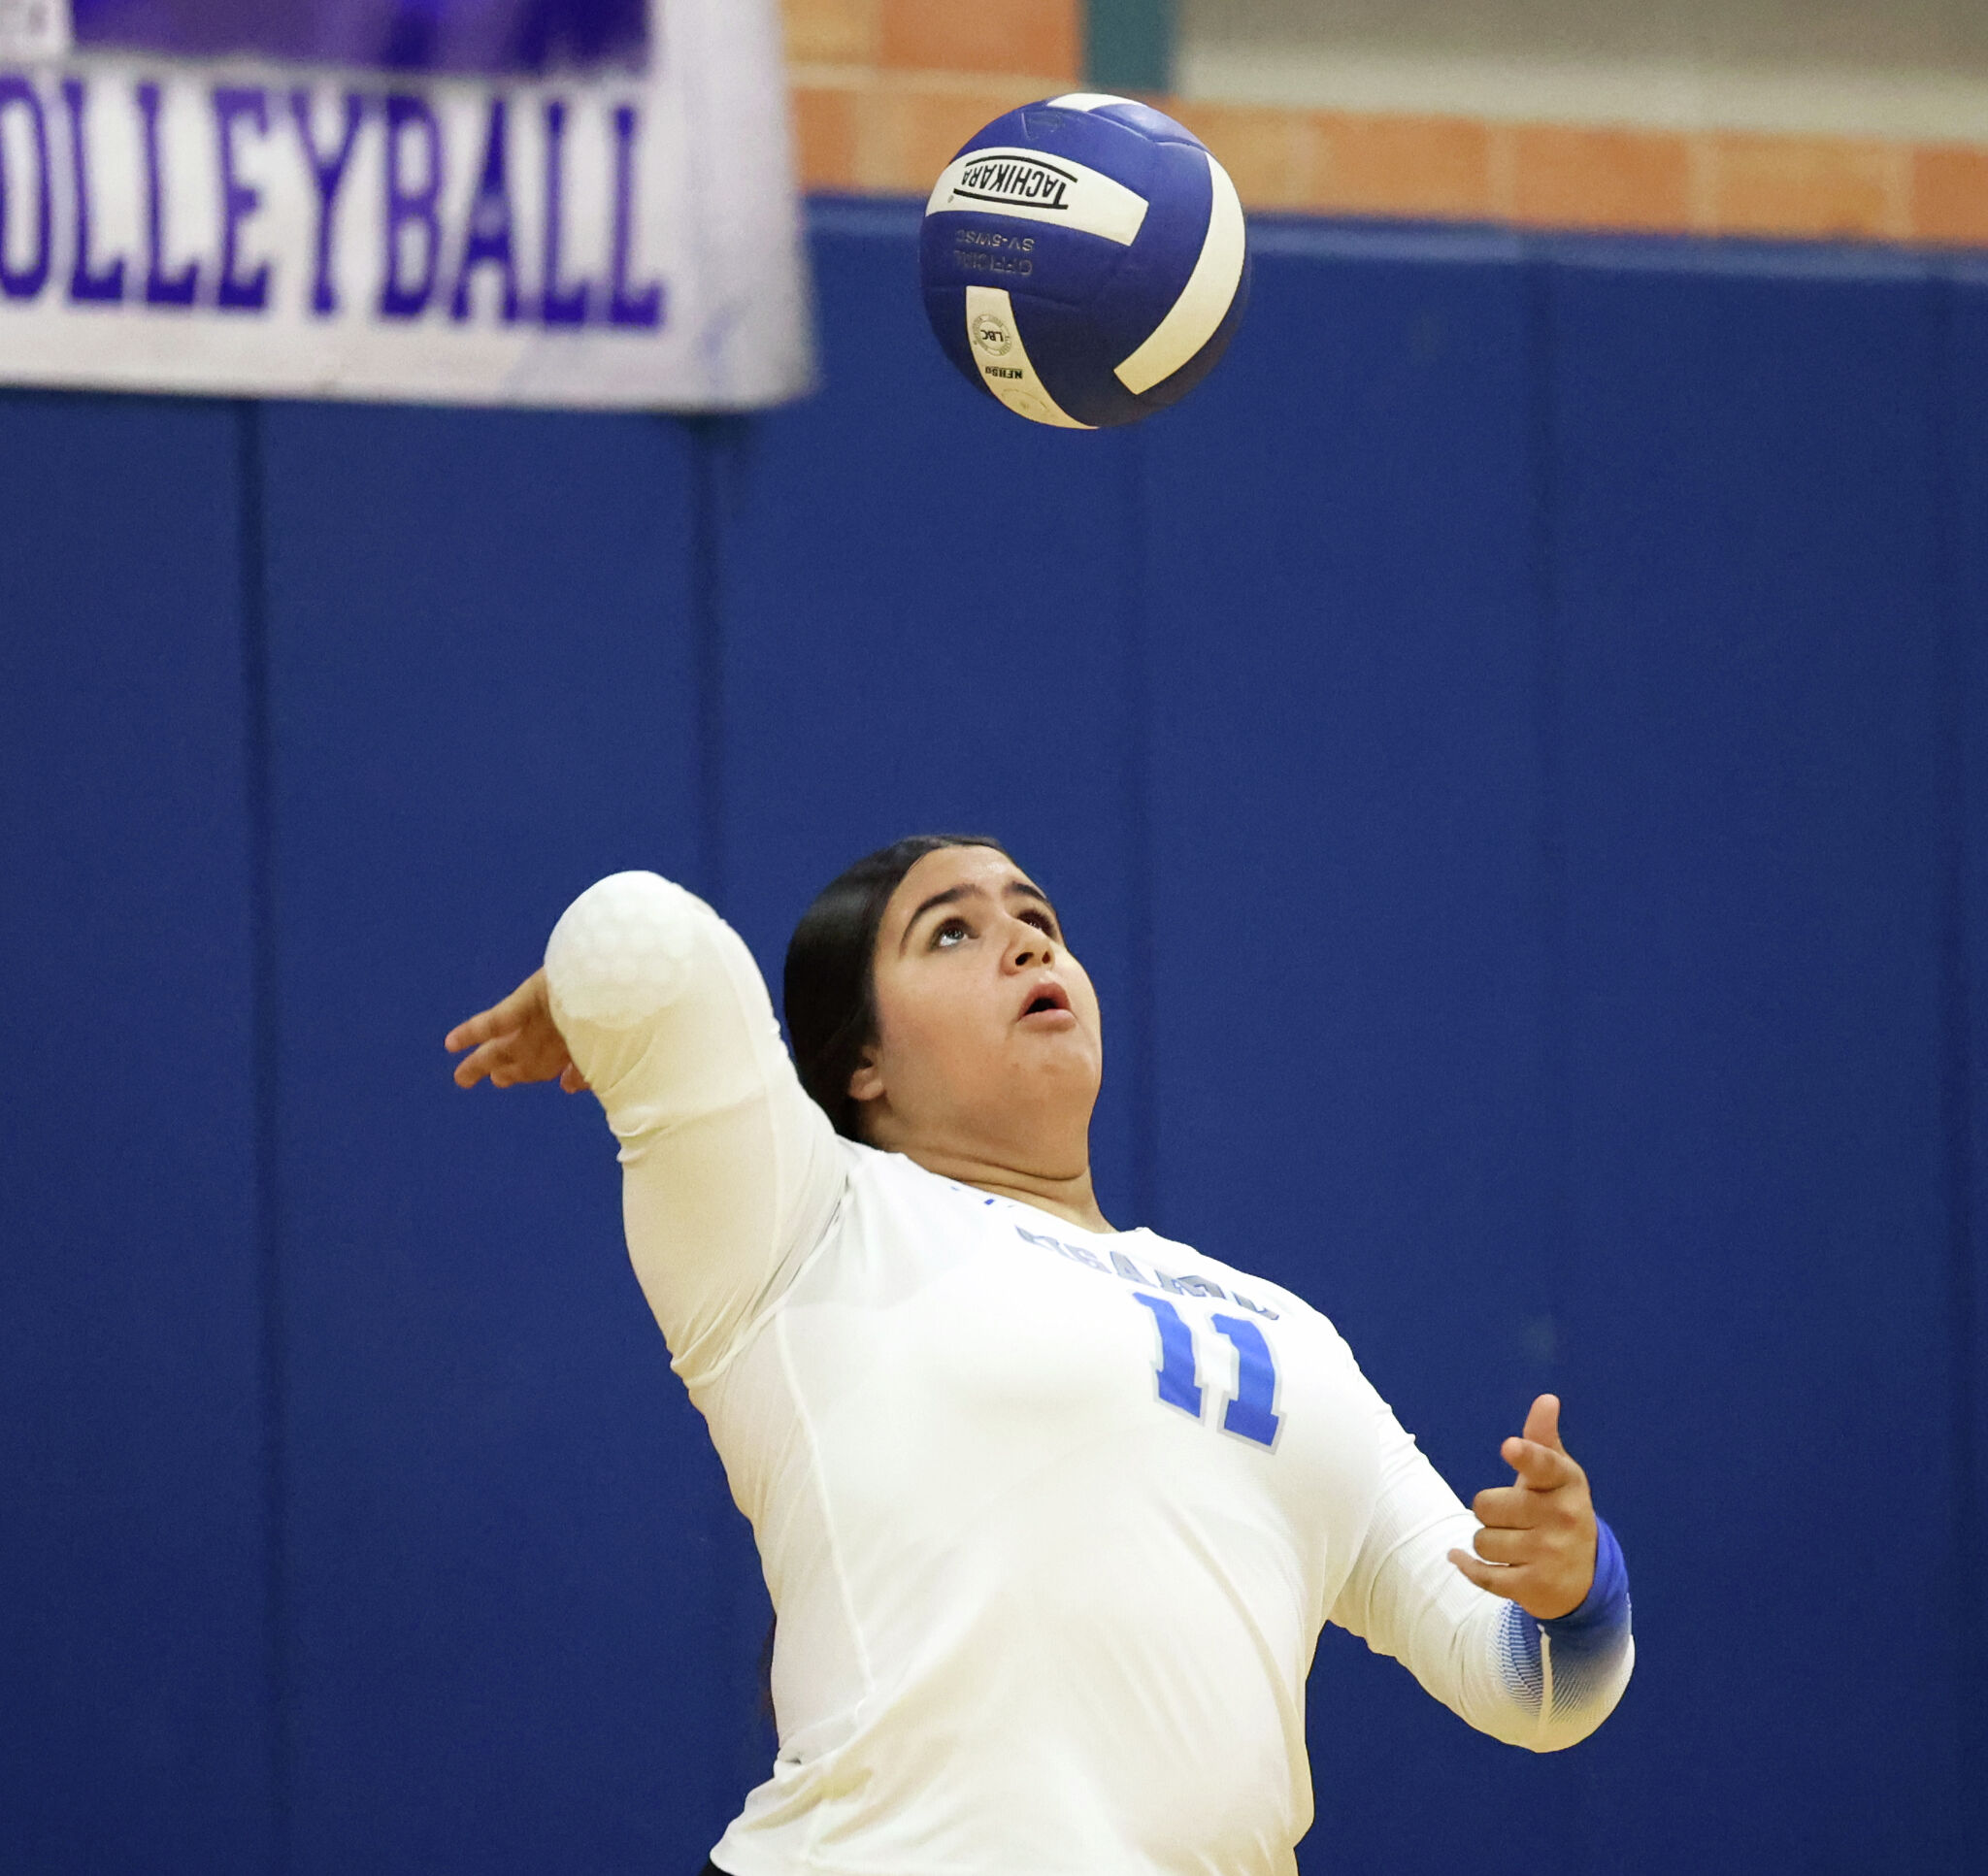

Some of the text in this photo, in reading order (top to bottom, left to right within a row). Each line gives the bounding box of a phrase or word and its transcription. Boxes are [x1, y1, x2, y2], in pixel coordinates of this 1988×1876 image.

[953, 163, 1069, 210] TACHIKARA
[954, 250, 1032, 276] OFFICIAL
[980, 330, 1005, 343] LBC
[1130, 1291, 1286, 1455] 11
